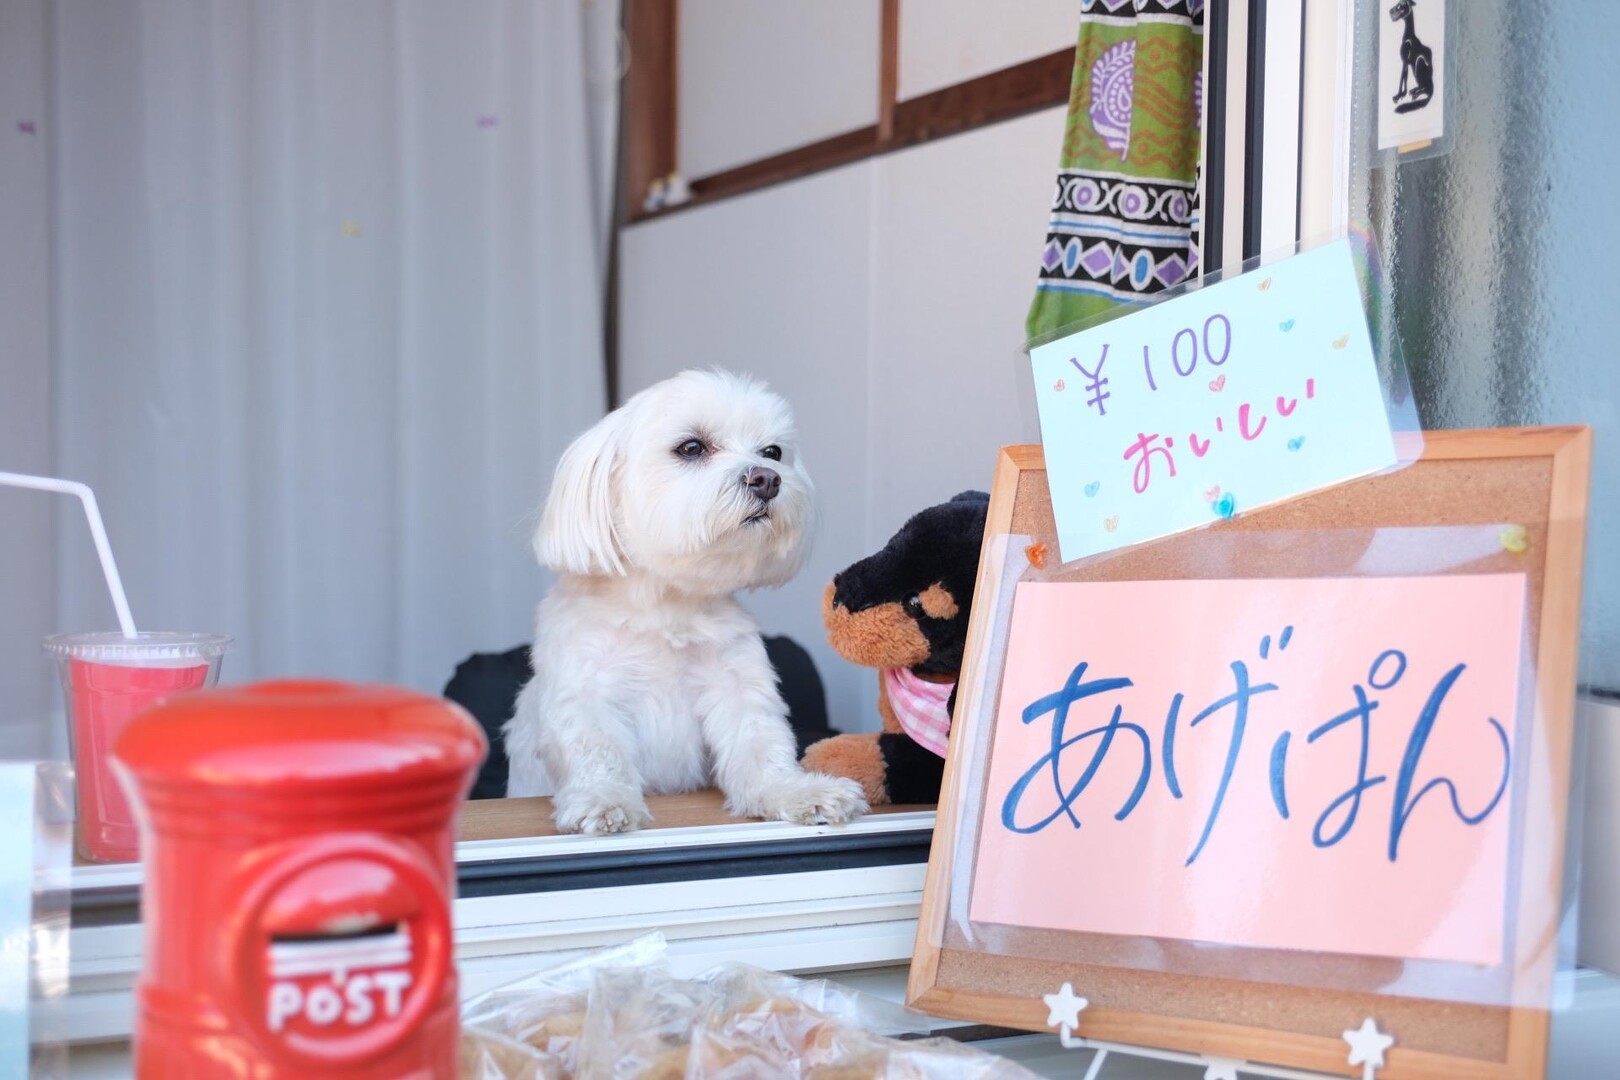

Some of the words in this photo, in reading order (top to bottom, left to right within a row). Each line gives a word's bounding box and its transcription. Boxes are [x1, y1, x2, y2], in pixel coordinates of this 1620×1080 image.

[1069, 313, 1232, 416] ¥100
[1122, 378, 1315, 494] おいしい
[1000, 625, 1511, 867] あげぱん
